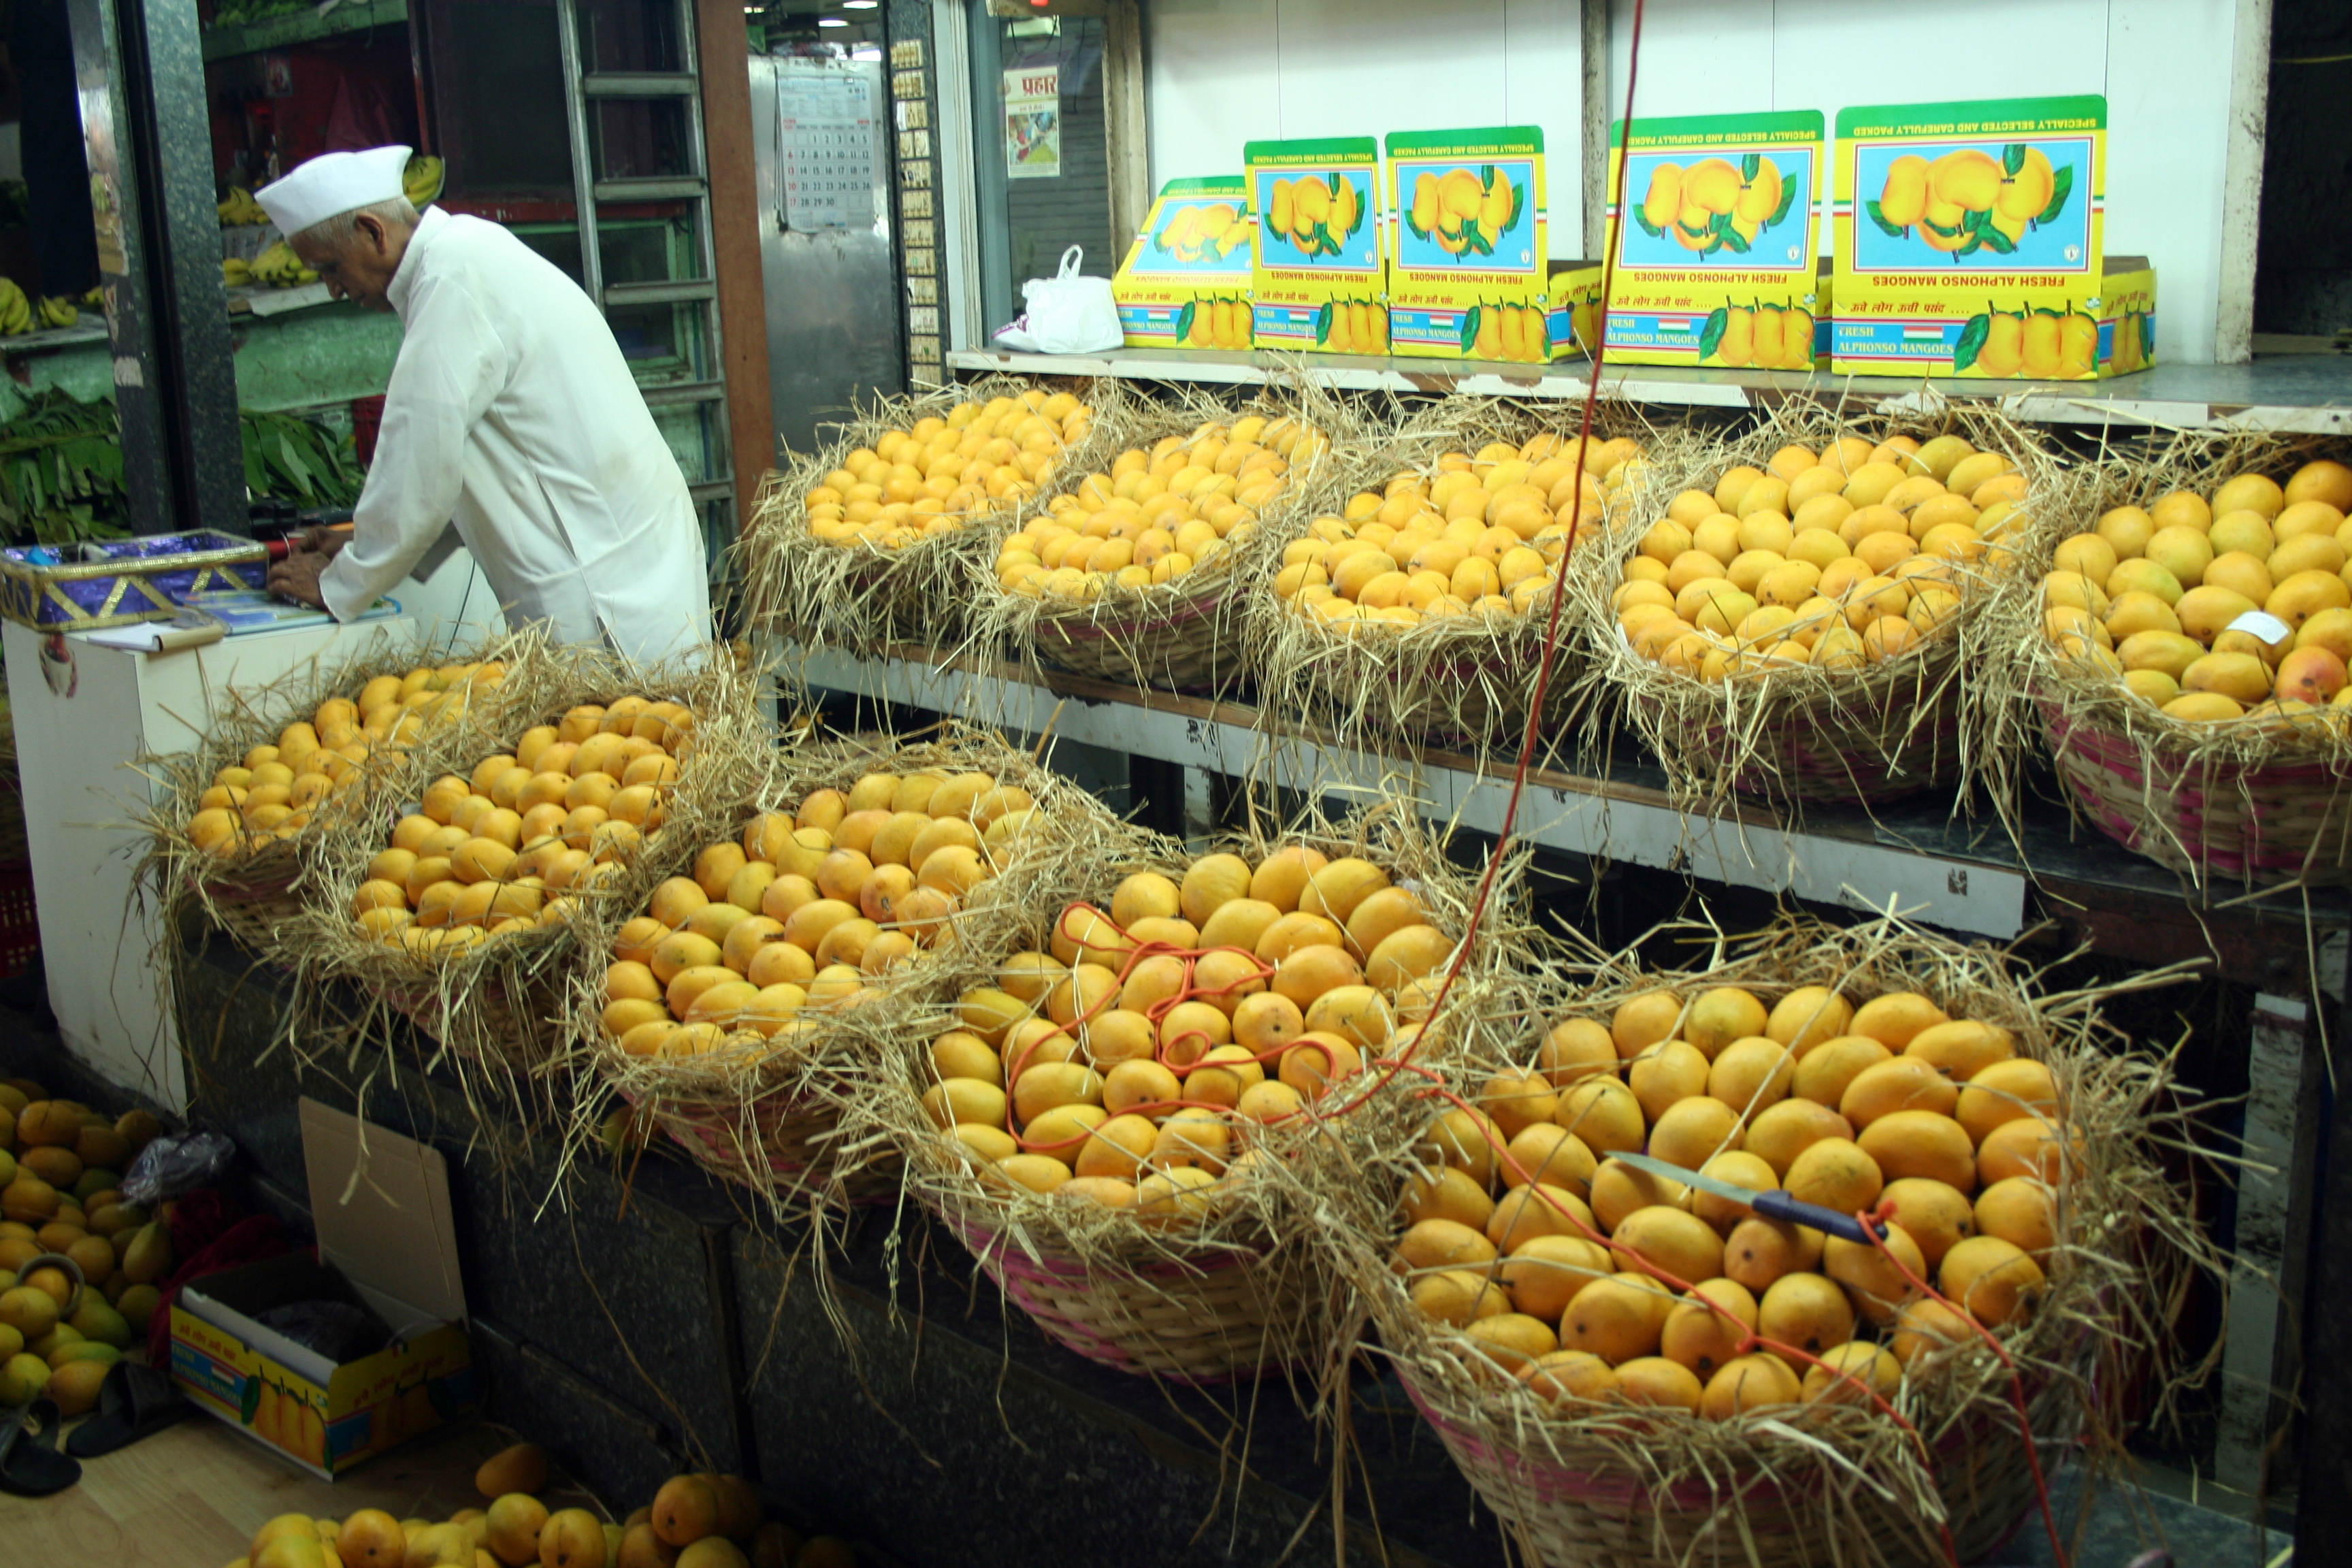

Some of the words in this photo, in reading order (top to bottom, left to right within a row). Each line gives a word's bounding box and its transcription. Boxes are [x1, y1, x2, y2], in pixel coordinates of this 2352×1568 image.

[1958, 123, 1978, 133] AND
[1982, 120, 2036, 131] SELECTED
[2038, 118, 2097, 129] SPECIALLY
[1853, 126, 1894, 136] PACKED
[1896, 124, 1954, 135] CAREFULLY
[1657, 135, 1703, 145] CAREFULLY
[1705, 134, 1722, 143] AND
[1725, 133, 1767, 142] SELECTED
[1769, 131, 1815, 140] SPECIALLY
[1628, 137, 1655, 146] PACKE
[1271, 272, 1303, 281] MANGOES
[1305, 273, 1342, 282] ALPHONSO
[1345, 274, 1368, 283] FRESH
[1409, 273, 1448, 283] MANGOES
[1450, 274, 1494, 284] ALPHONSO
[1497, 276, 1523, 285] FRESH
[1634, 272, 1685, 282] MANGOES
[1689, 274, 1747, 283] ALPHONSO
[1752, 274, 1787, 284] FRESH
[1873, 276, 1937, 287] MANGOES
[1942, 276, 2014, 287] ALPHONSO
[2020, 276, 2065, 287] FRESH
[1872, 301, 1893, 313] लोग
[1392, 314, 1413, 324] FRESH
[1607, 318, 1634, 328] FRESH
[1392, 327, 1427, 337] ALPHONSO
[1428, 329, 1460, 339] MANGOES
[1839, 327, 1874, 337] FRESH
[1607, 332, 1653, 343] ALPHONSO
[1656, 333, 1699, 344] MANGOES
[1838, 342, 1897, 353] ALPHONSO
[1900, 344, 1954, 354] MANGOES
